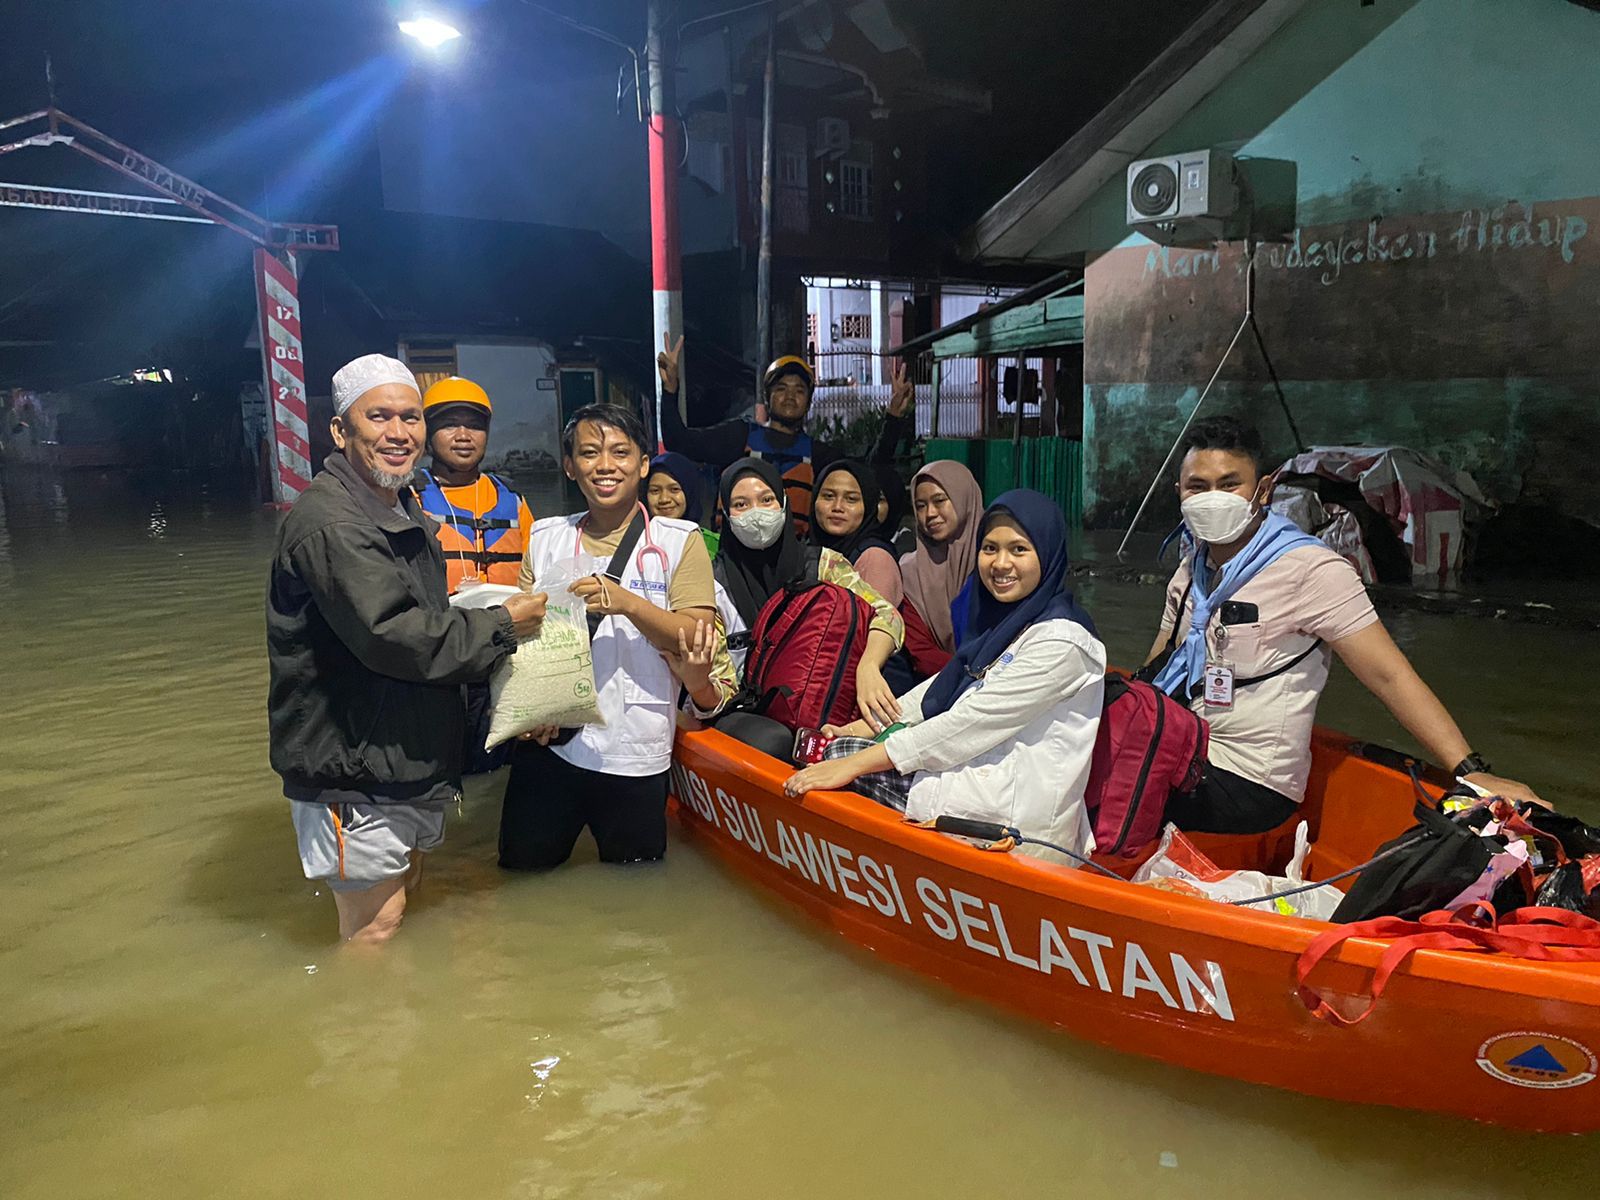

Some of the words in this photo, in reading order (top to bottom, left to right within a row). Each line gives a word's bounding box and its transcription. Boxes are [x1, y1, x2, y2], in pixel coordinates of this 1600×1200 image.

[1449, 203, 1588, 264] Hidup
[276, 306, 294, 320] 17
[716, 787, 911, 924] SULAWESI
[917, 876, 1235, 1021] SELATAN
